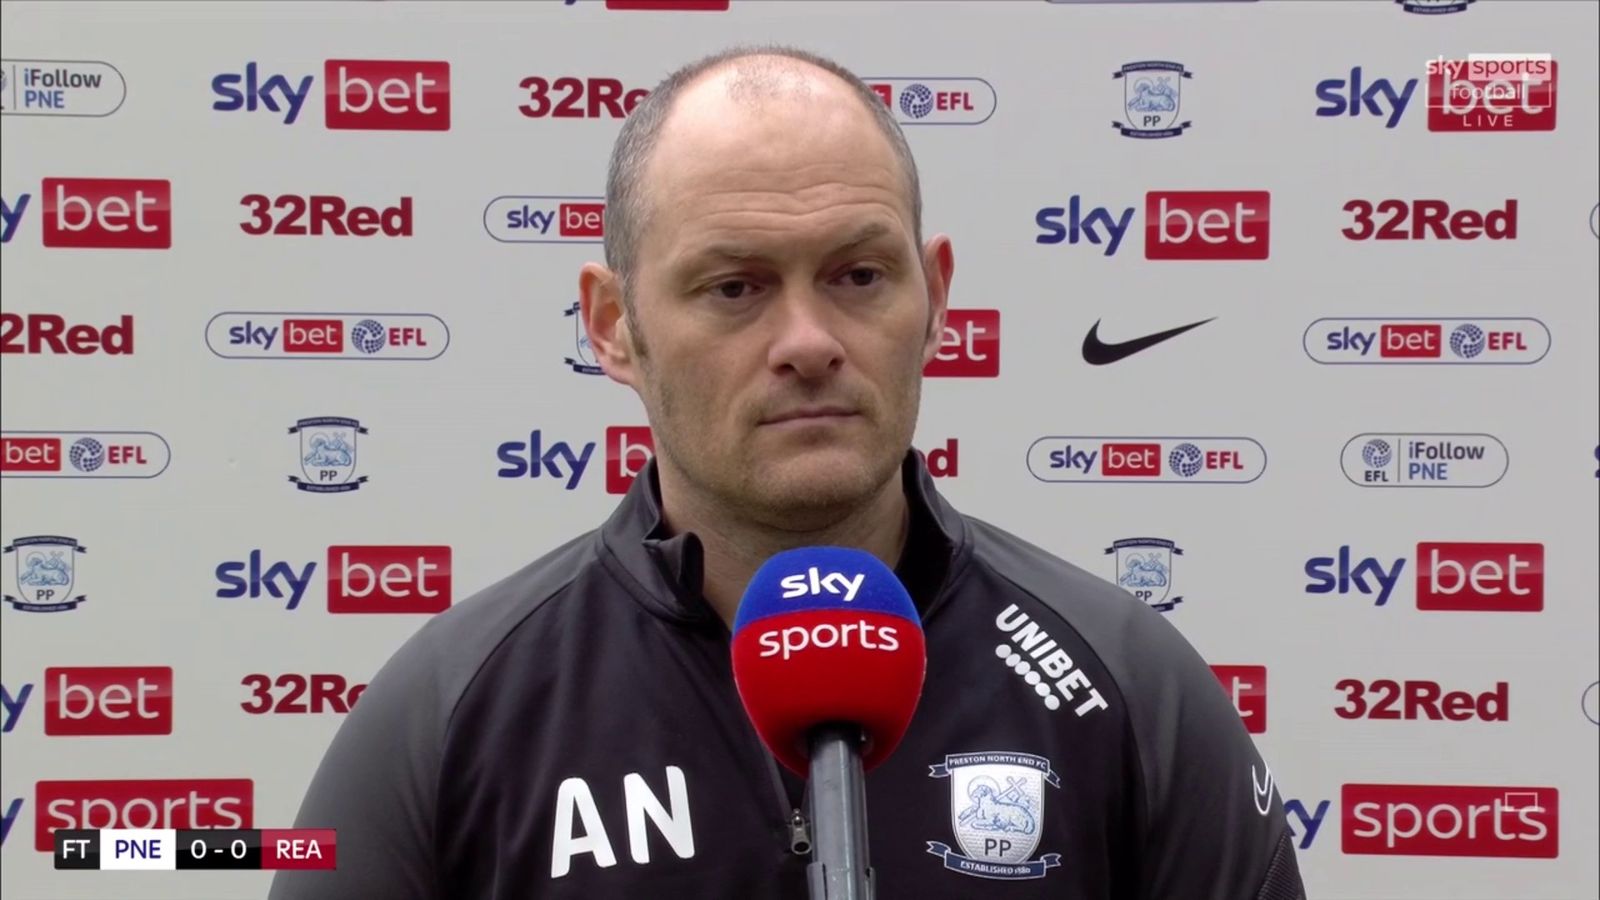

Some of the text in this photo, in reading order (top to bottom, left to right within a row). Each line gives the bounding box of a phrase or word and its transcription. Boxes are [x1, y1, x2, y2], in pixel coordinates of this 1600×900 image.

[25, 69, 101, 88] iFollow
[212, 62, 436, 124] sky bet
[518, 76, 651, 118] 32R
[1316, 67, 1544, 128] sky bet
[25, 90, 64, 108] PNE
[936, 91, 975, 111] EFL
[1143, 115, 1161, 127] PP
[57, 185, 157, 231] bet
[240, 194, 413, 237] 32Red
[507, 205, 605, 234] sky be
[1036, 195, 1255, 256] sky bet
[1342, 199, 1518, 241] 32Red
[1, 312, 134, 356] 2Red
[229, 320, 427, 350] sky bet EFL
[935, 320, 987, 361] et
[1327, 326, 1527, 355] sky bet EFL
[6, 441, 147, 464] bet EFL
[497, 430, 596, 490] sky
[1049, 445, 1243, 475] sky bet EFL
[1409, 442, 1484, 459] iFollow
[320, 470, 338, 481] PP
[1365, 470, 1388, 482] EFL
[1409, 463, 1447, 480] PNE
[36, 589, 54, 601] PP
[216, 549, 437, 610] sky bet
[780, 567, 865, 601] sky
[1305, 545, 1529, 606] sky bet
[759, 620, 899, 660] sports
[996, 603, 1109, 717] UNIBET
[60, 674, 158, 718] bet
[240, 674, 368, 714] 32R
[1334, 679, 1509, 722] 32Red
[949, 755, 1047, 769] PRESTON NORTH END FC
[47, 790, 242, 830] sports
[551, 766, 695, 878] AN
[1353, 798, 1547, 848] sports
[985, 838, 1011, 857] PP
[960, 861, 1013, 875] ESTABLISHED
